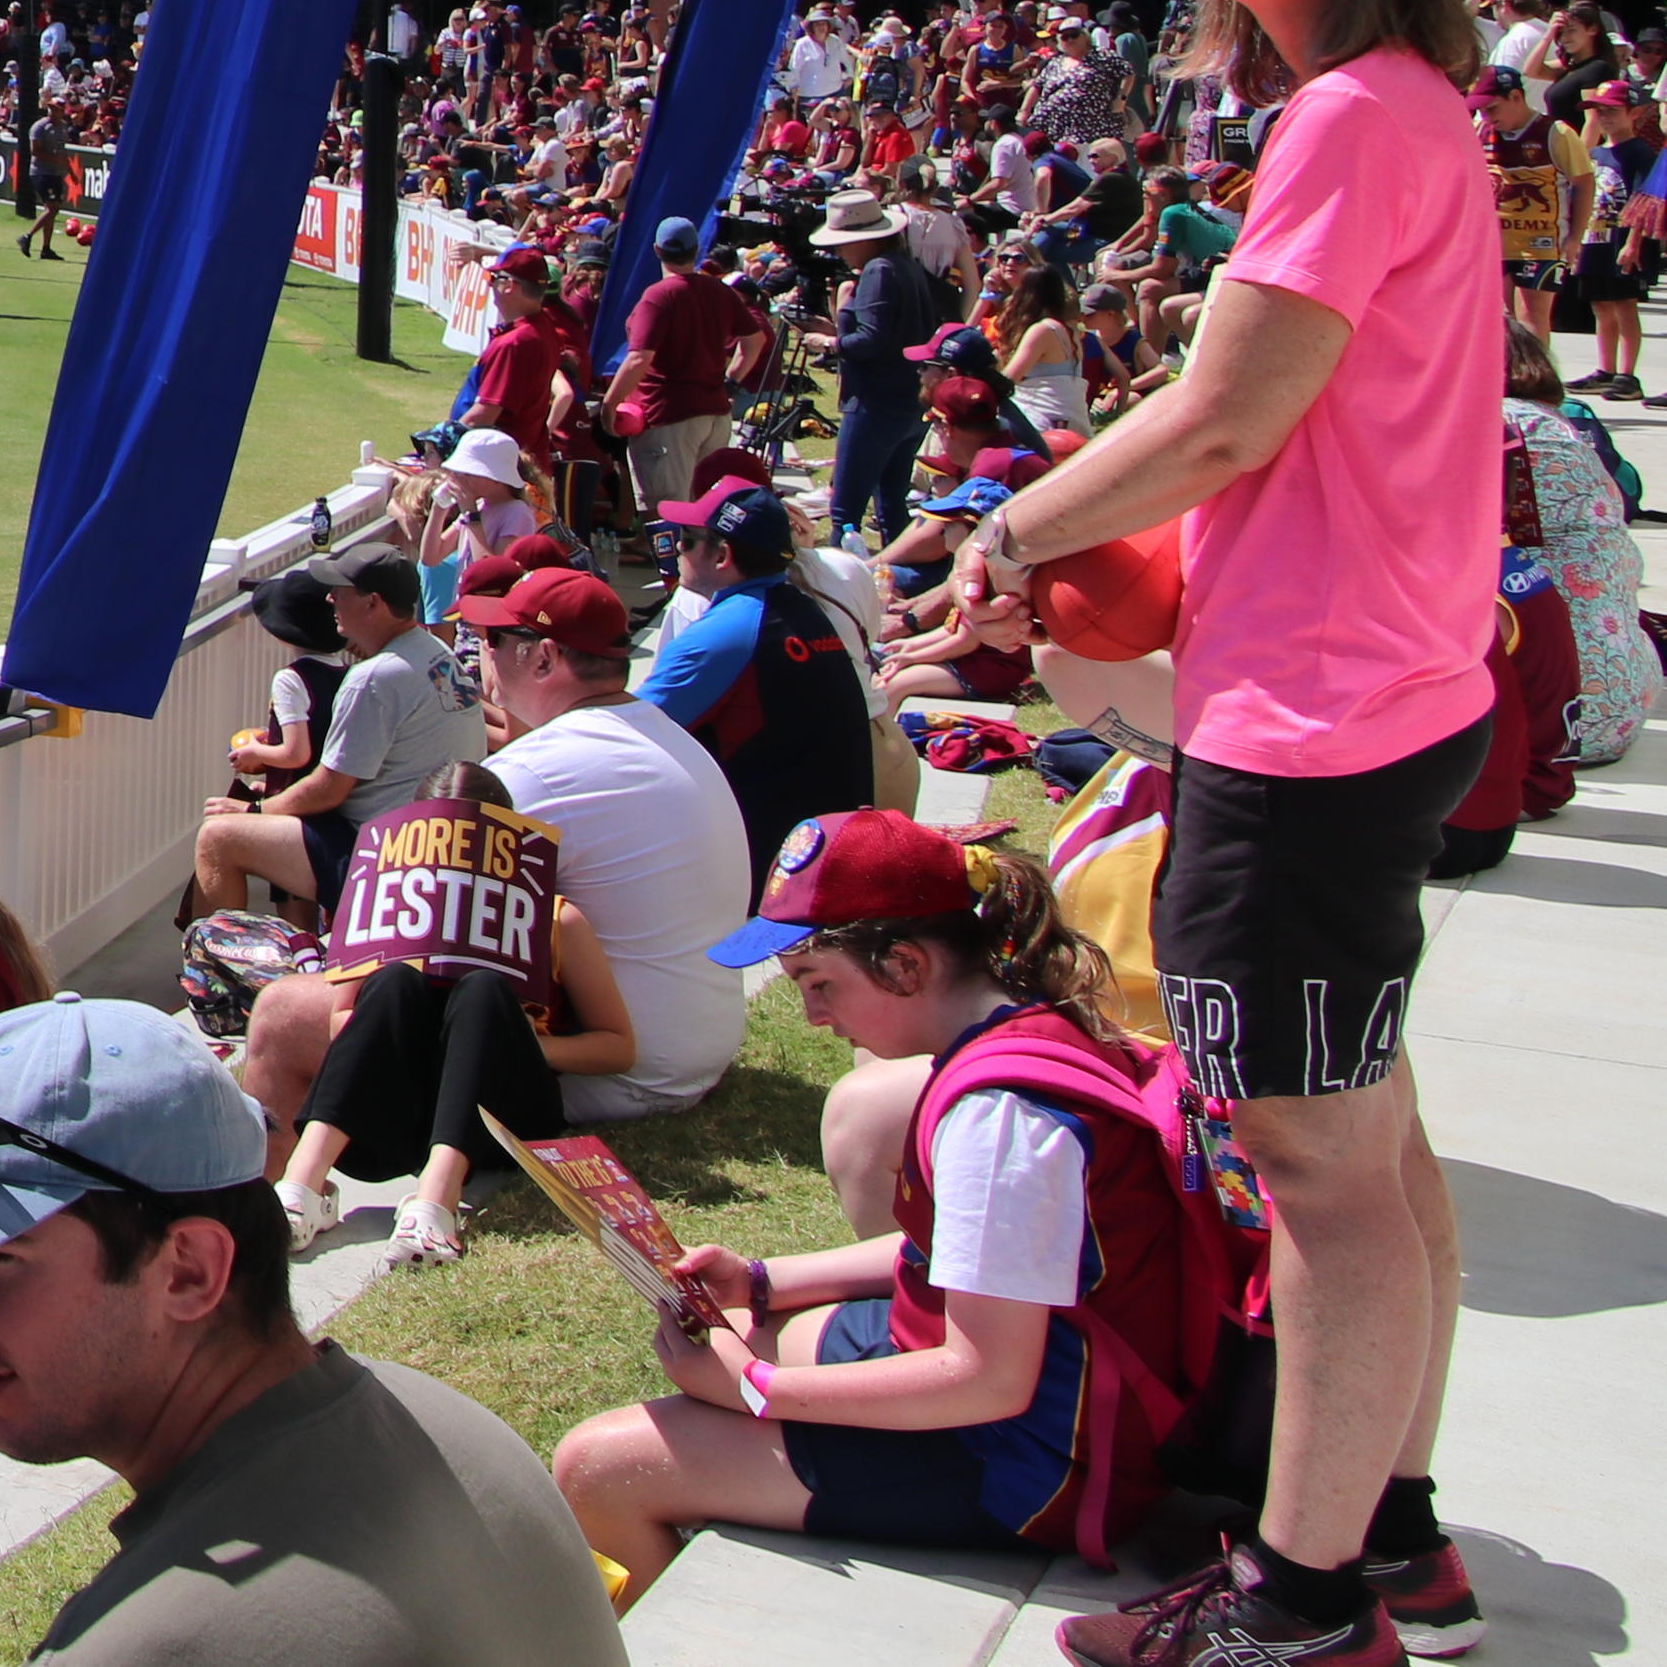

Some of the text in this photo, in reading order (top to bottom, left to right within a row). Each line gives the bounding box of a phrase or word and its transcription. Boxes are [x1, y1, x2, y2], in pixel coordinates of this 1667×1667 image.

[407, 220, 435, 285] BHP
[376, 817, 516, 880] MORE IS
[344, 866, 536, 966] LESTER
